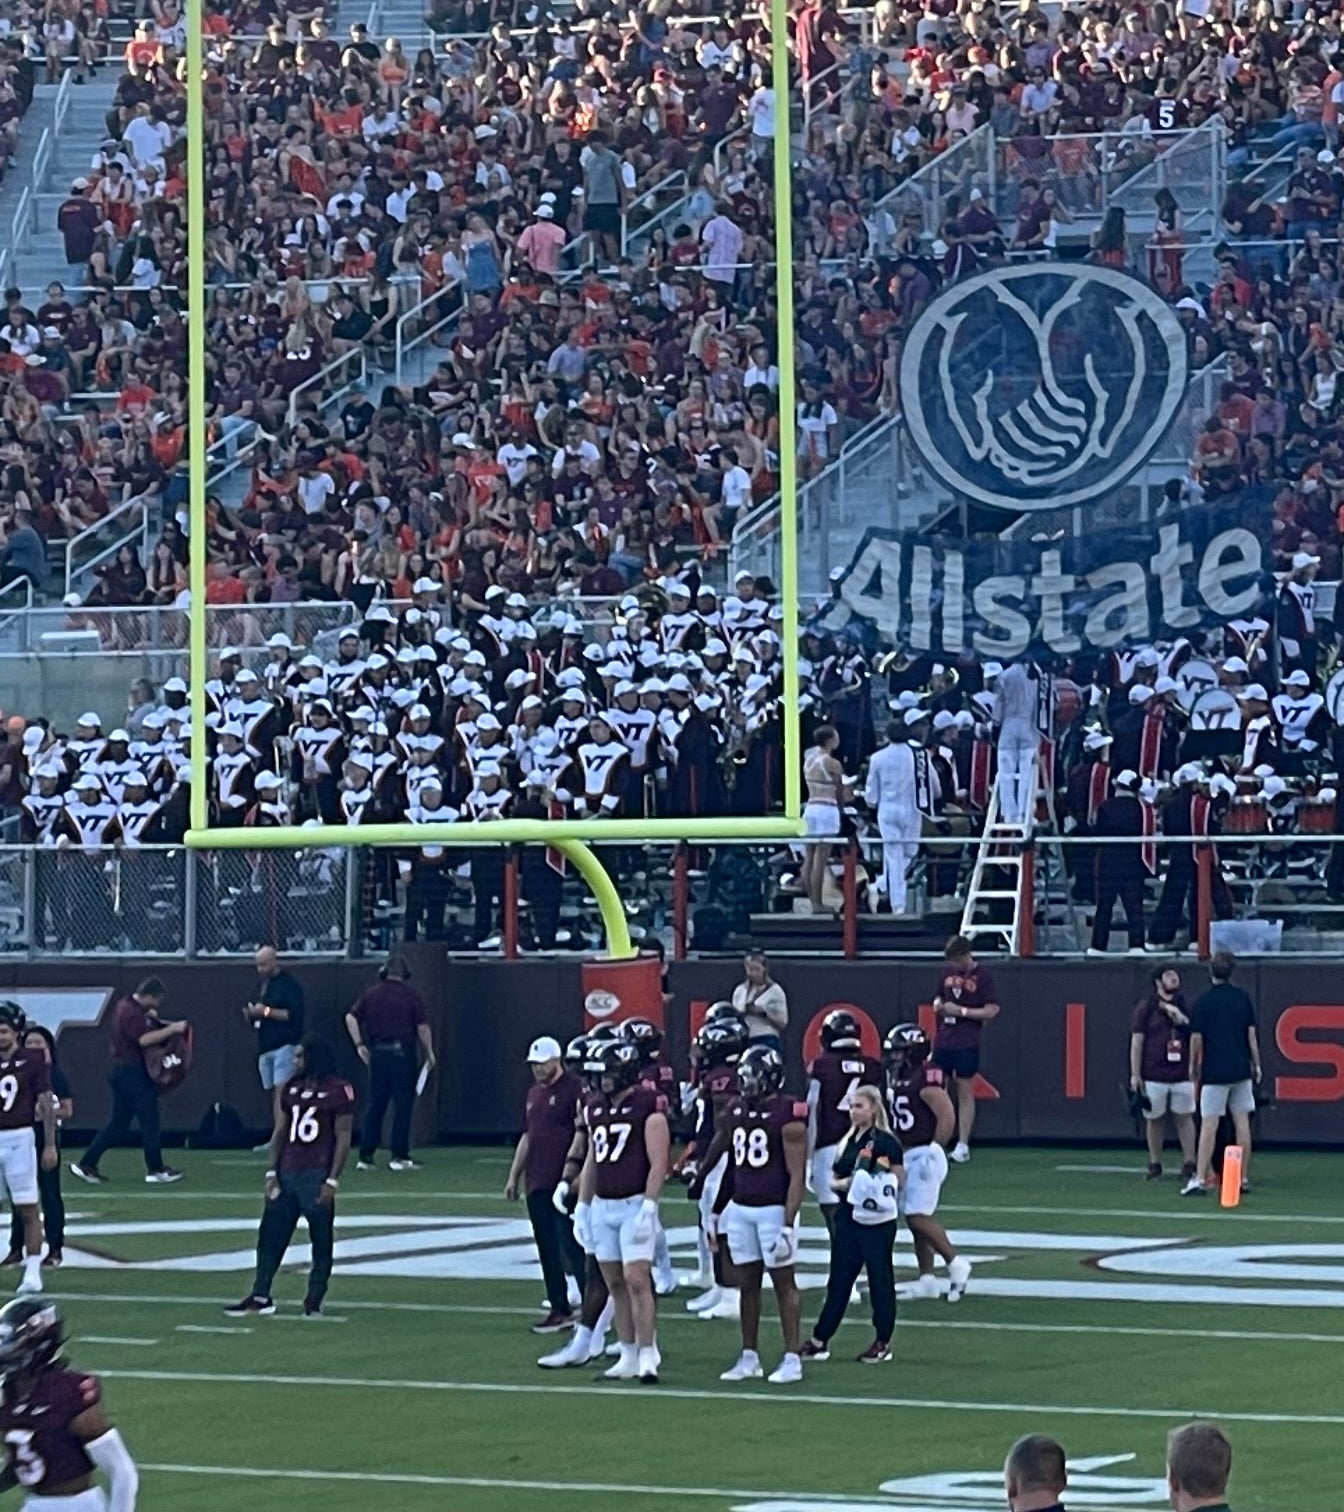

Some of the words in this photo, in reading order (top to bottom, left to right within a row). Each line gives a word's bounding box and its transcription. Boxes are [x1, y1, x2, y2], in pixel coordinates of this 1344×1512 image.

[1159, 105, 1174, 128] 5
[822, 526, 1264, 660] Allstate
[290, 1105, 319, 1143] 16
[594, 1123, 632, 1163] 87
[733, 1126, 769, 1167] 88
